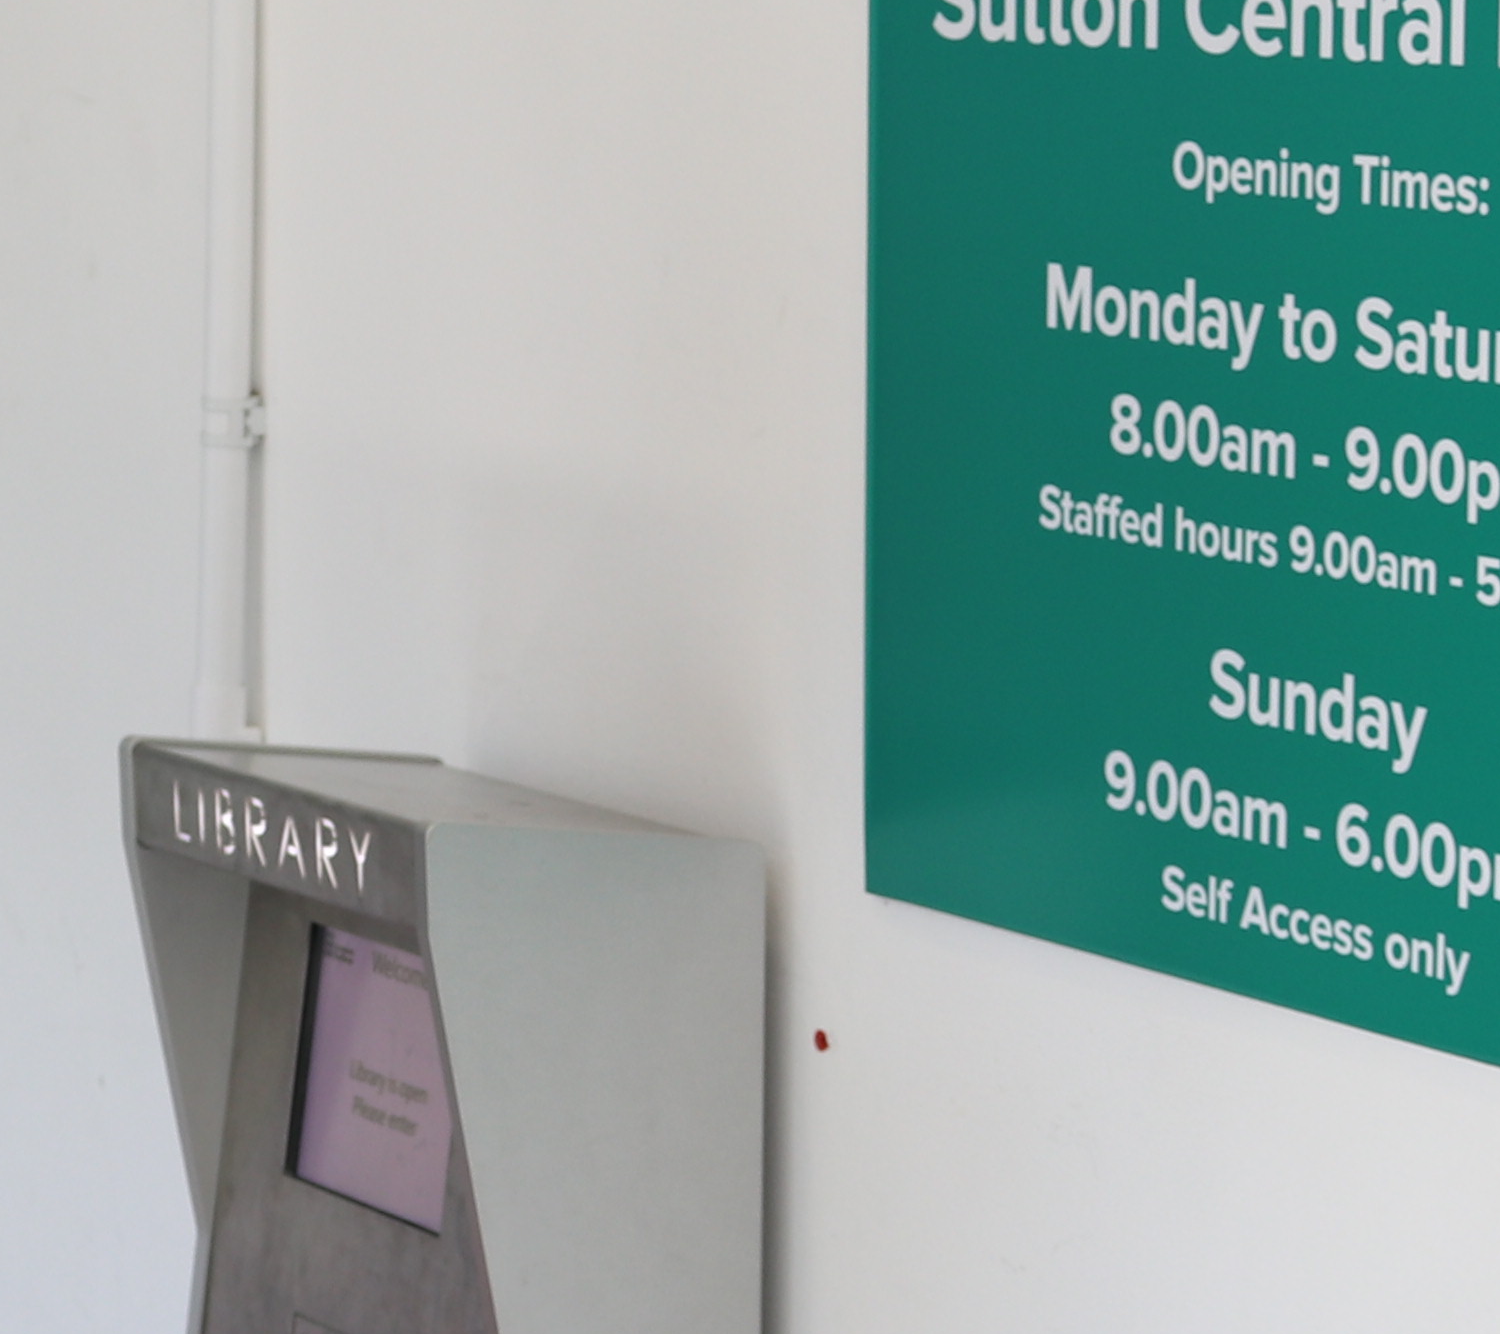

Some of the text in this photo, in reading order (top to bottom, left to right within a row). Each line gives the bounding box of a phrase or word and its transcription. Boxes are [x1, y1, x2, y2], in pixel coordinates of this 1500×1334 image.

[1174, 142, 1489, 215] Opening Times:
[1047, 264, 1263, 370] Monday
[1279, 294, 1336, 361] to
[1111, 395, 1295, 478] 8.00am
[1314, 455, 1328, 466] -
[1040, 485, 1162, 547] Staffed
[1176, 509, 1277, 566] hours
[1290, 526, 1436, 595] 9.00am
[1450, 577, 1462, 586] -
[1210, 650, 1427, 773] Sunday
[173, 779, 371, 892] LIBRARY
[1105, 751, 1286, 848] 9.00am
[1305, 827, 1320, 839] -
[1163, 866, 1470, 995] Self Access only
